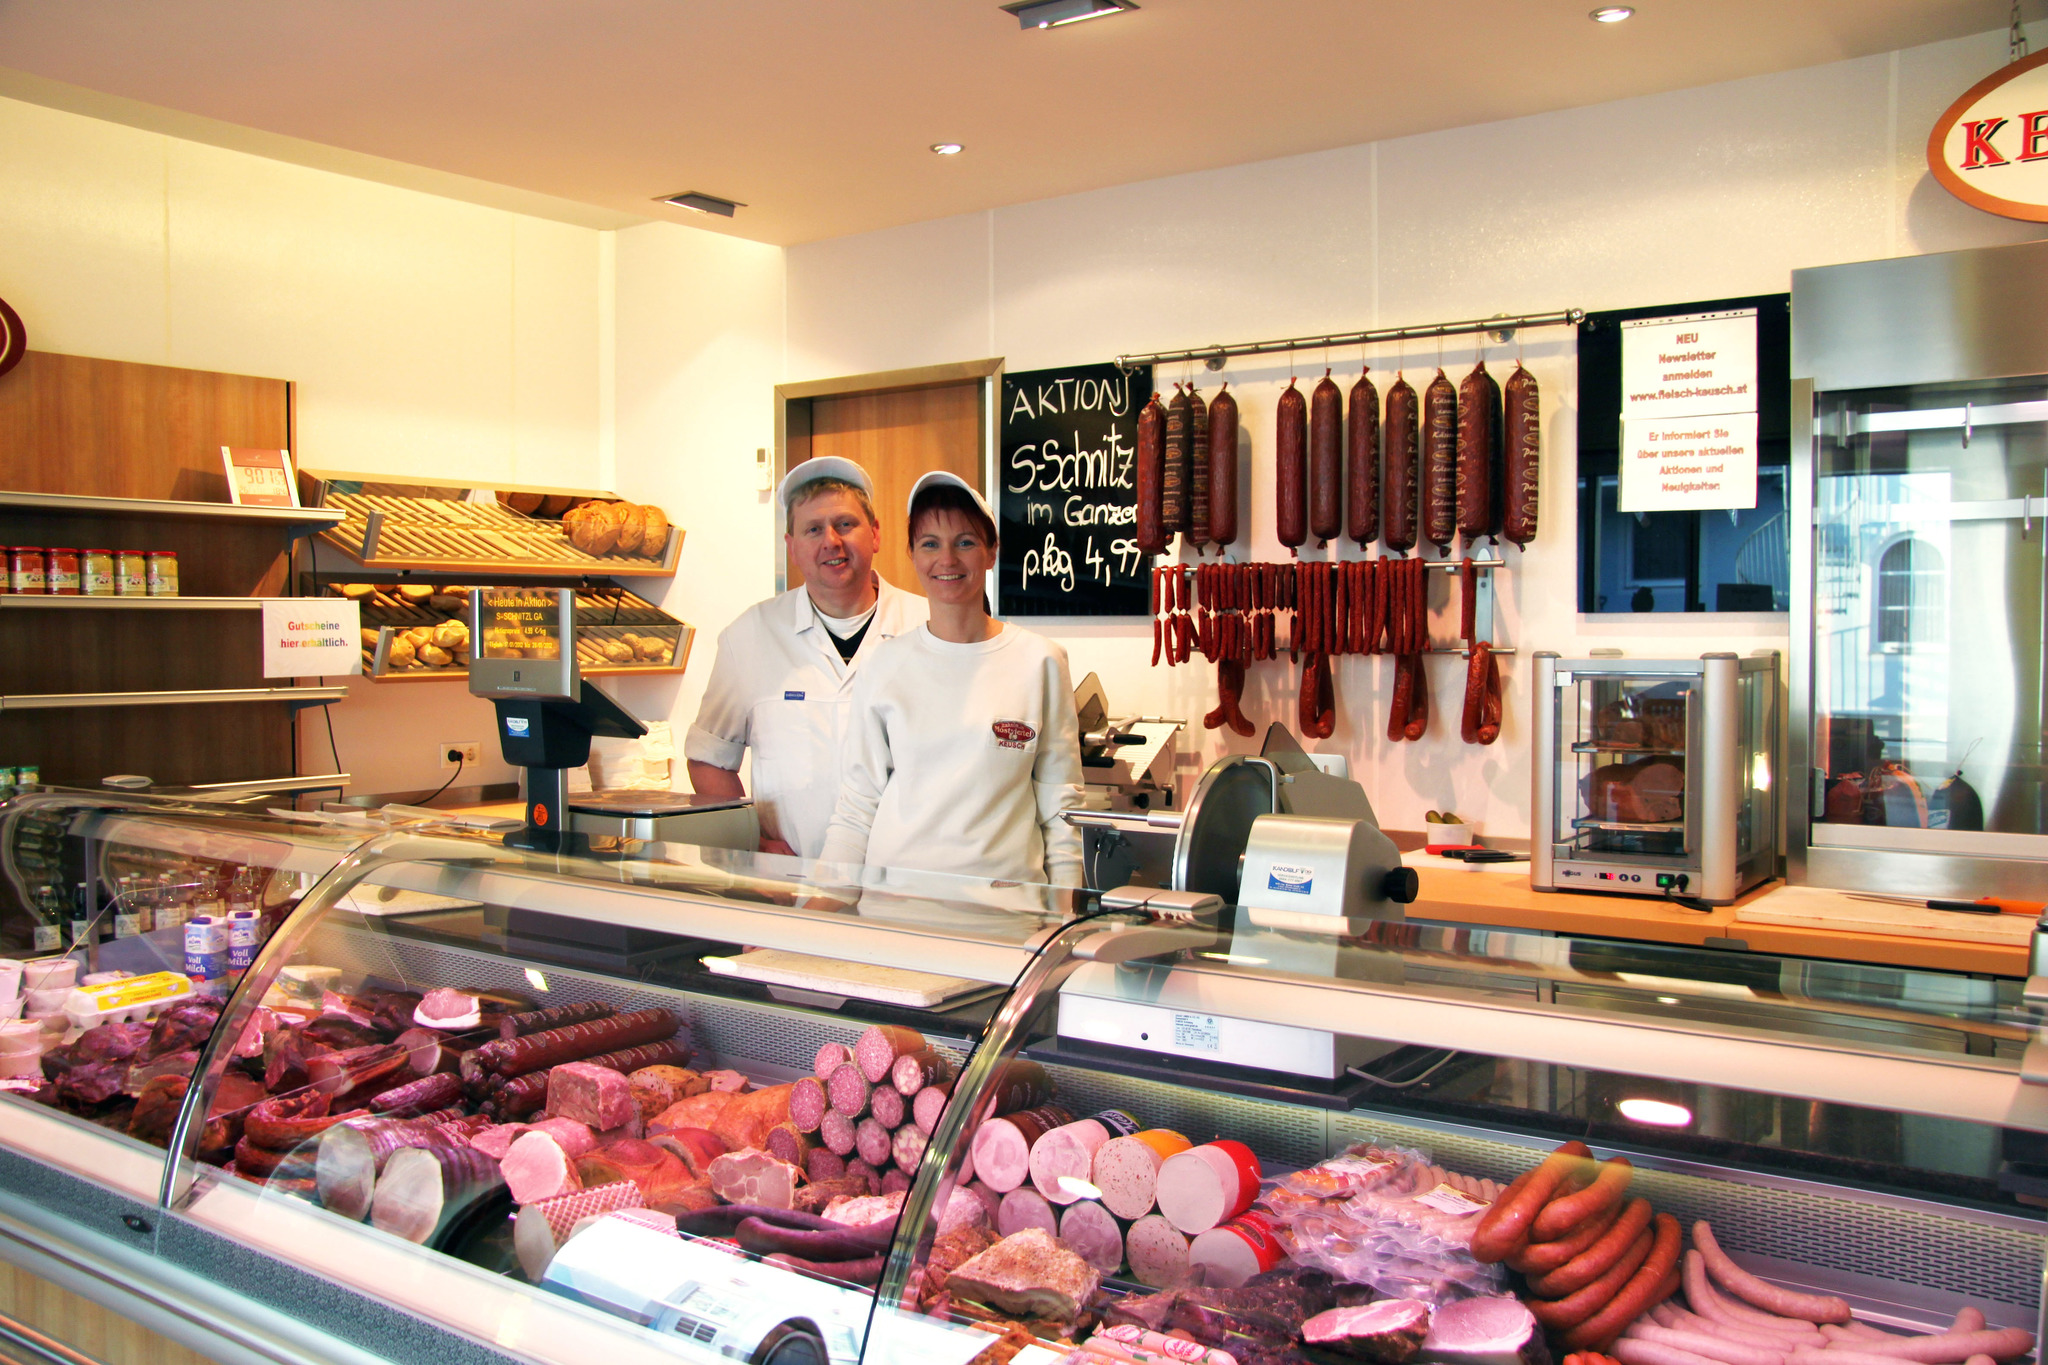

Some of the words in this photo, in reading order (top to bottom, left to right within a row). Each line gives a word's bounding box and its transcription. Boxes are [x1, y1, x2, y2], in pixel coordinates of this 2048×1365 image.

[1676, 333, 1699, 345] NEU
[1659, 351, 1717, 364] Newsletter
[1662, 369, 1713, 381] anmelden
[1630, 384, 1748, 402] www.fleisch-keusch.at
[1649, 432, 1659, 441] Er
[1714, 429, 1729, 439] Sie
[1637, 449, 1659, 459] über
[1662, 449, 1695, 459] unsere
[1698, 446, 1744, 457] aktuellen
[1659, 465, 1702, 475] Aktionen
[1706, 463, 1724, 473] und
[1027, 497, 1052, 526] im
[1085, 535, 1141, 588] 4,99
[494, 597, 515, 607] Heute
[524, 597, 547, 607] Aktion
[533, 612, 544, 621] GA
[288, 621, 340, 631] Gutscheine
[280, 638, 299, 648] hier
[301, 637, 348, 648] erhältlich.
[999, 741, 1025, 750] KEUSCH
[188, 956, 202, 964] Voll
[228, 957, 253, 966] Milch
[185, 964, 206, 972] Milch
